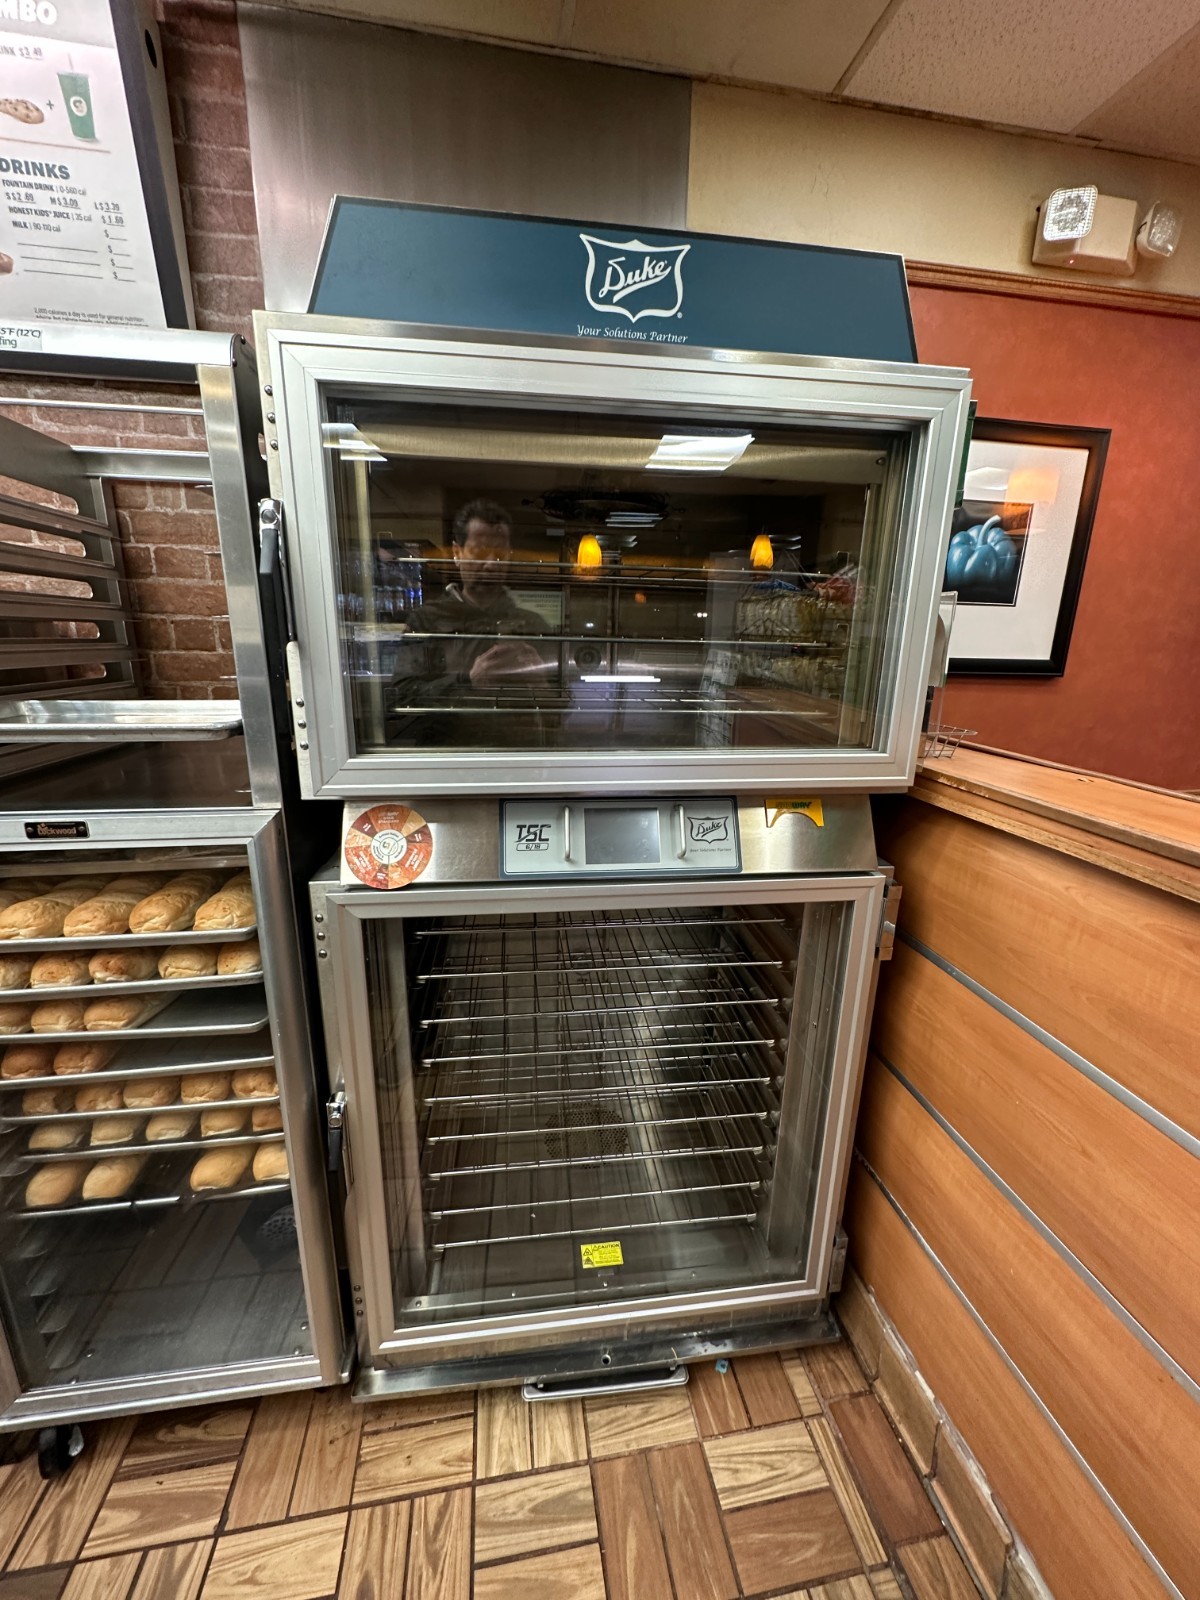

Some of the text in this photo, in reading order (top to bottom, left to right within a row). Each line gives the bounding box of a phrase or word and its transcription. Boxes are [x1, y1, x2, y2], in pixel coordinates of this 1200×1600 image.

[0, 158, 70, 180] DRINKS
[2, 179, 34, 190] FOUNTAIN
[34, 182, 54, 192] DRINK
[78, 188, 87, 196] cal
[8, 206, 34, 216] HONEST
[53, 210, 70, 220] JUICE
[12, 220, 28, 229] MILK
[598, 256, 672, 304] Duke
[577, 324, 688, 343] Your Solutions Partner
[515, 821, 722, 843] TSC Duke
